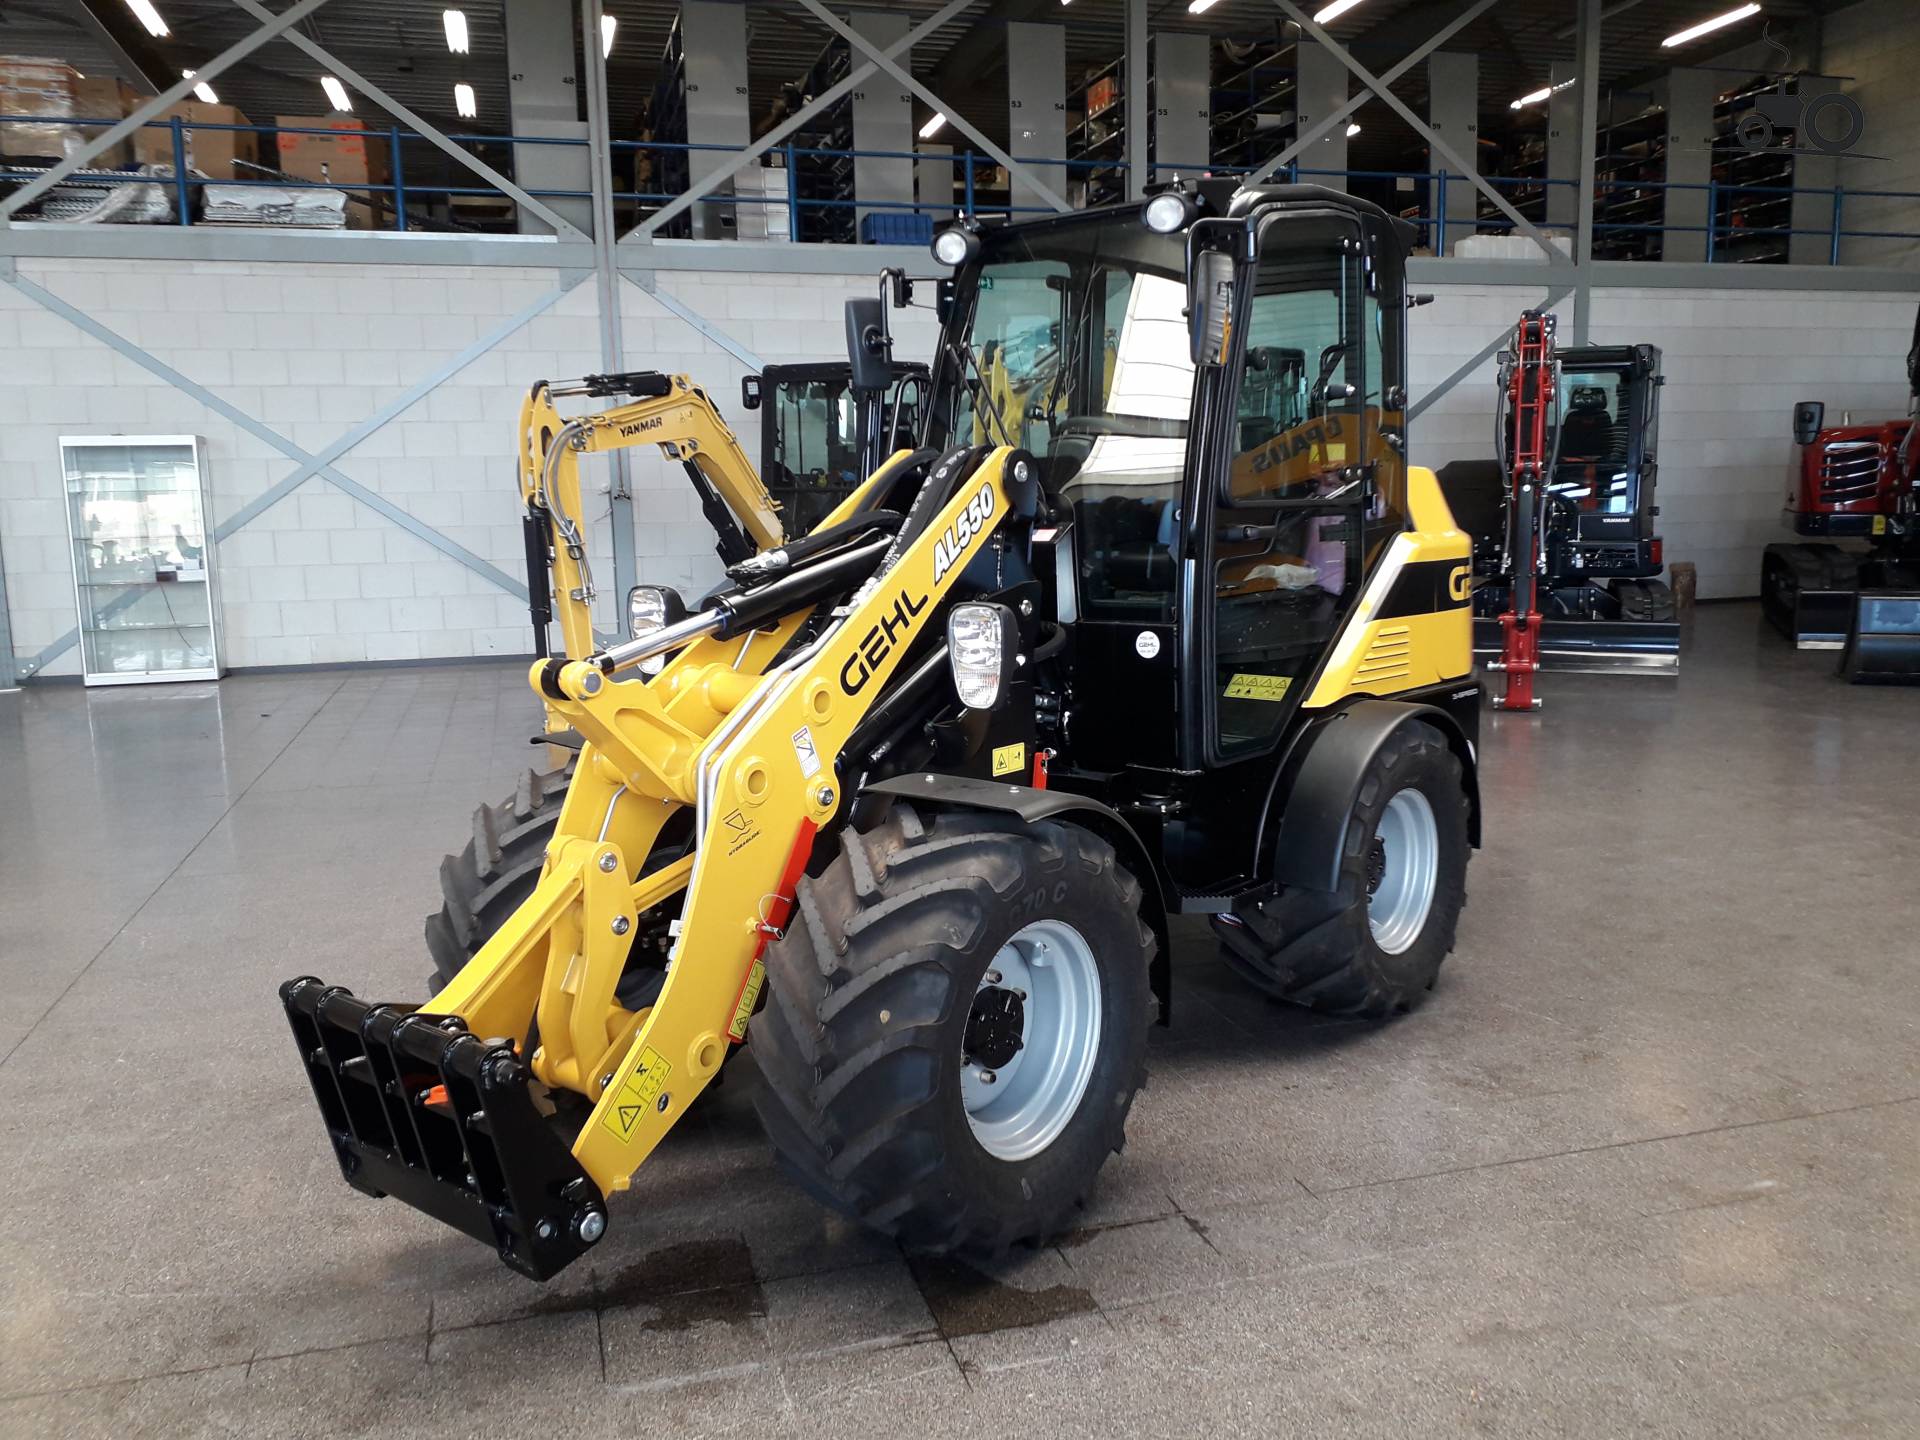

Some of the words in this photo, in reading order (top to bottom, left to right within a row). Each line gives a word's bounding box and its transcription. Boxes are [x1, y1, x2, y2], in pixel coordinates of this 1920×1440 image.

[735, 86, 748, 95] 50
[854, 92, 865, 100] 51
[900, 95, 911, 103] 52
[1010, 100, 1022, 108] 53
[1054, 102, 1065, 111] 54
[1157, 108, 1168, 116] 55
[1299, 115, 1309, 123] 57
[619, 416, 663, 438] YANMAR
[840, 589, 928, 696] GEHL
[933, 481, 995, 588] AL550
